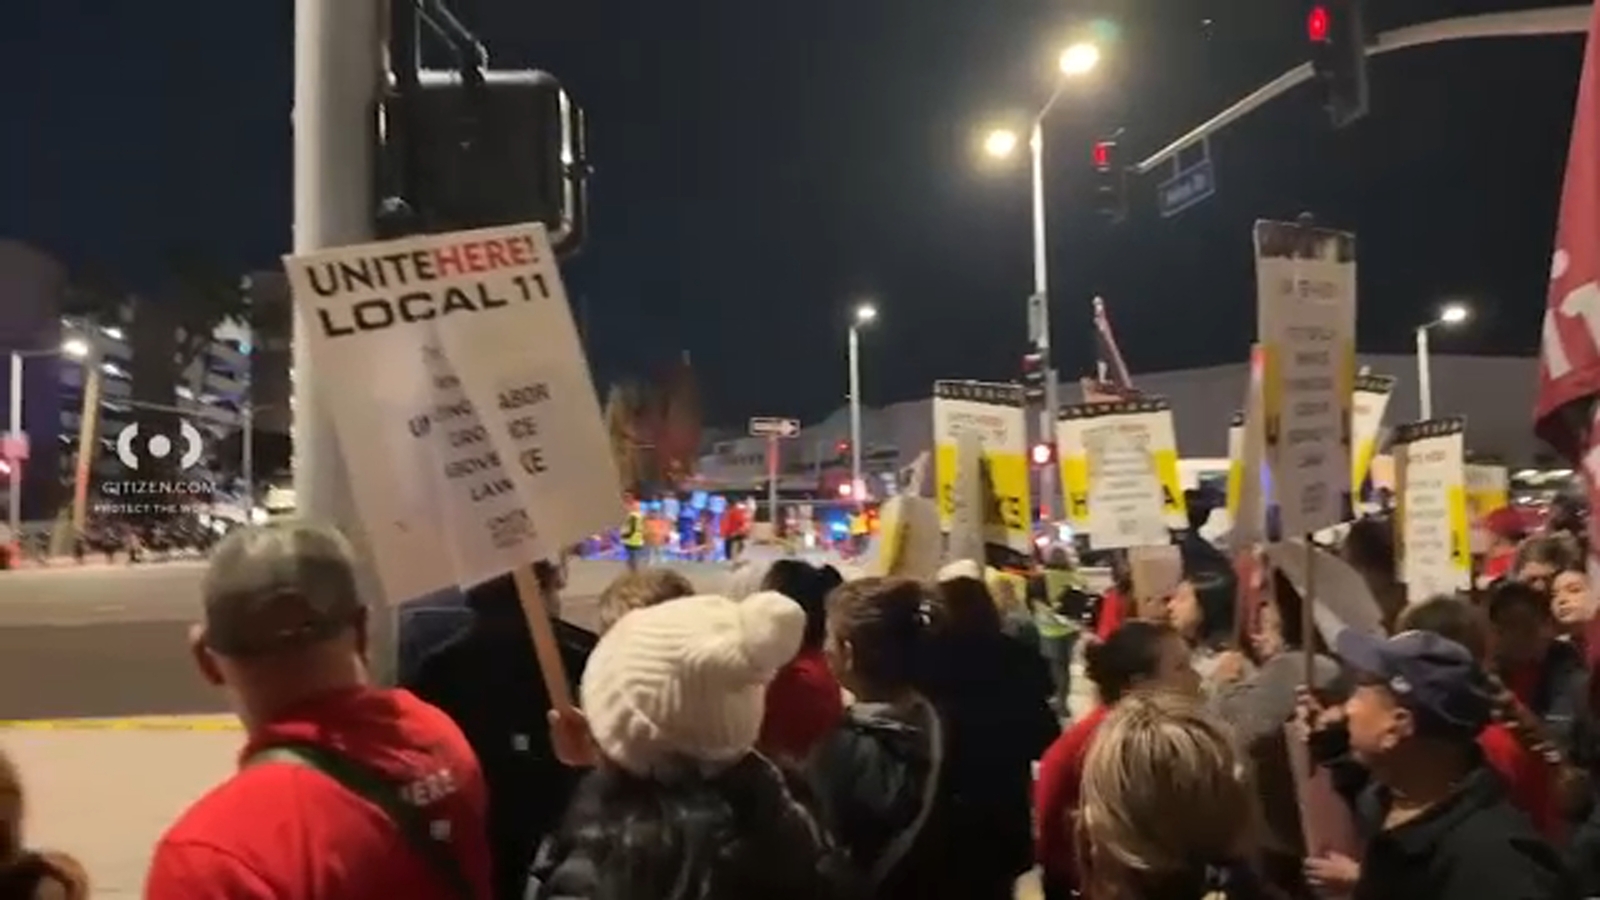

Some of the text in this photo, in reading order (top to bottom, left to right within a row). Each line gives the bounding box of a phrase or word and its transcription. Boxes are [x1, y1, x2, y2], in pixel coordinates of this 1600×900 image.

[317, 273, 550, 338] LOCAL 11
[498, 383, 551, 410] ABOR
